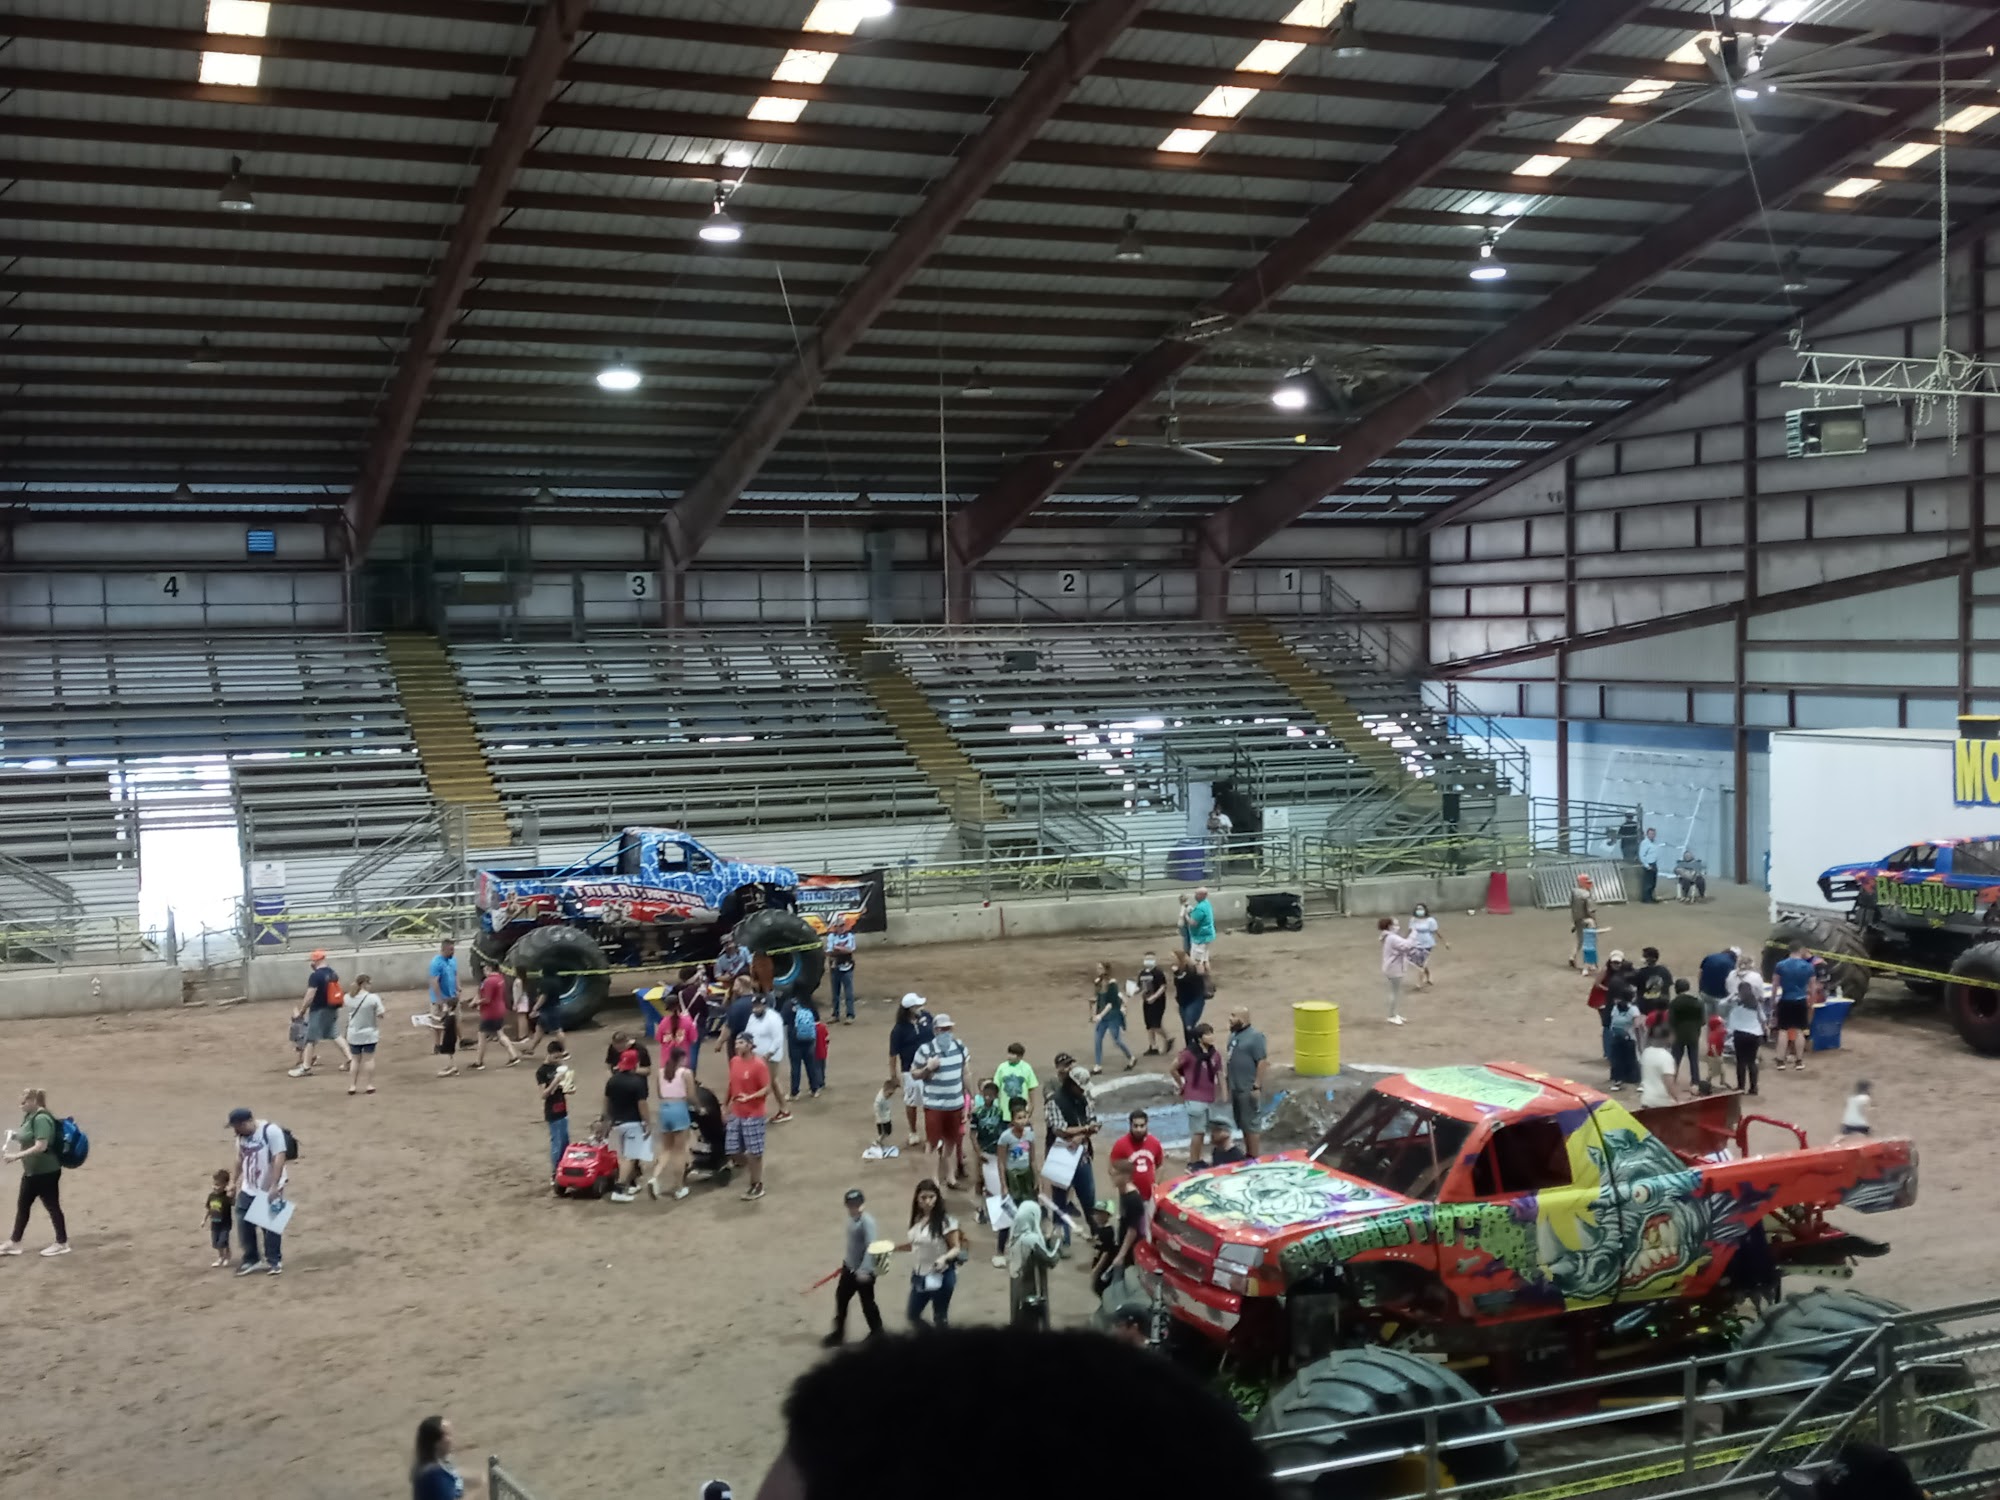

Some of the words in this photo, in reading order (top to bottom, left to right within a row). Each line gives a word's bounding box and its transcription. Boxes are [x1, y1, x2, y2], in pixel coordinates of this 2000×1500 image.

[163, 576, 180, 598] 4
[631, 575, 646, 596] 3
[1063, 573, 1075, 592] 2
[1284, 572, 1293, 590] 1
[573, 884, 619, 898] FATAL
[1876, 876, 1977, 915] BARBARIAN
